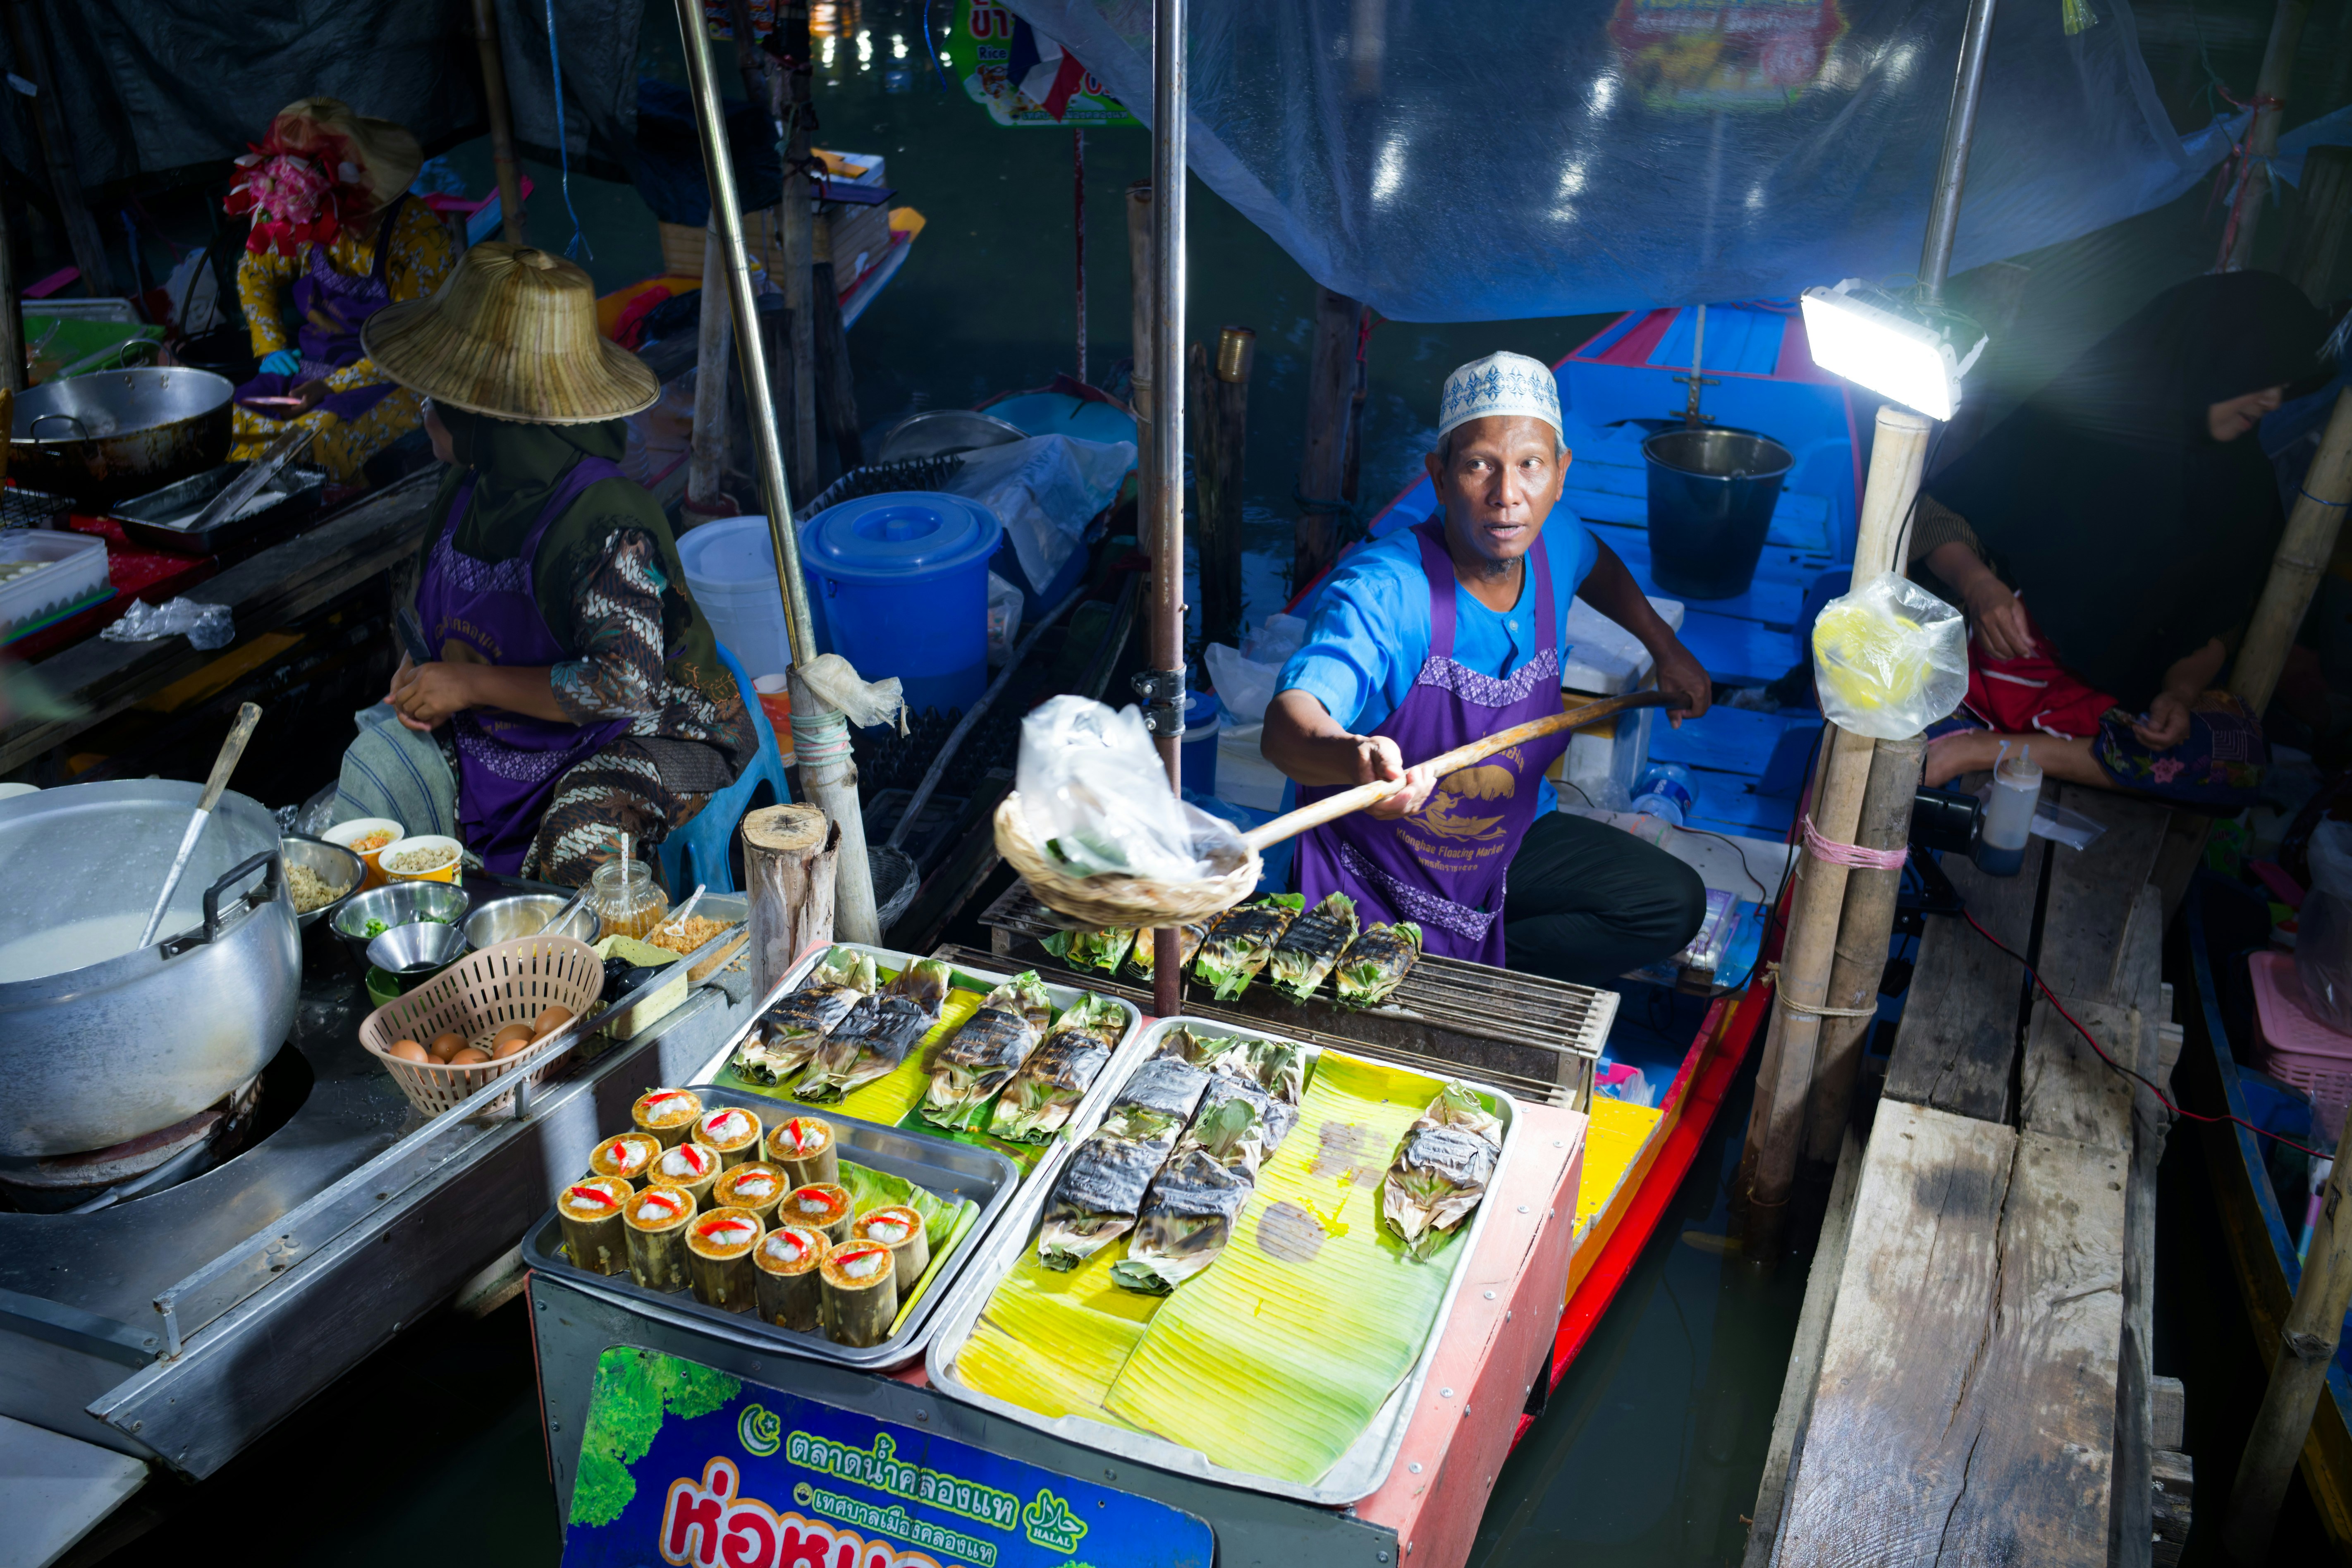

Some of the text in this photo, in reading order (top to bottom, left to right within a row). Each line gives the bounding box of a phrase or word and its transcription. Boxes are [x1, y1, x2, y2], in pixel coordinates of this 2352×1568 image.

[979, 47, 1007, 59] Rice
[1397, 828, 1504, 860] Klonghae Floating Market
[791, 1437, 1013, 1525] ตลาดน้ำคลองแห
[669, 1470, 924, 1568] ห่อห
[815, 1494, 994, 1563] เทศบาลเมืองคลองแห
[1033, 1527, 1071, 1548] HALAL
